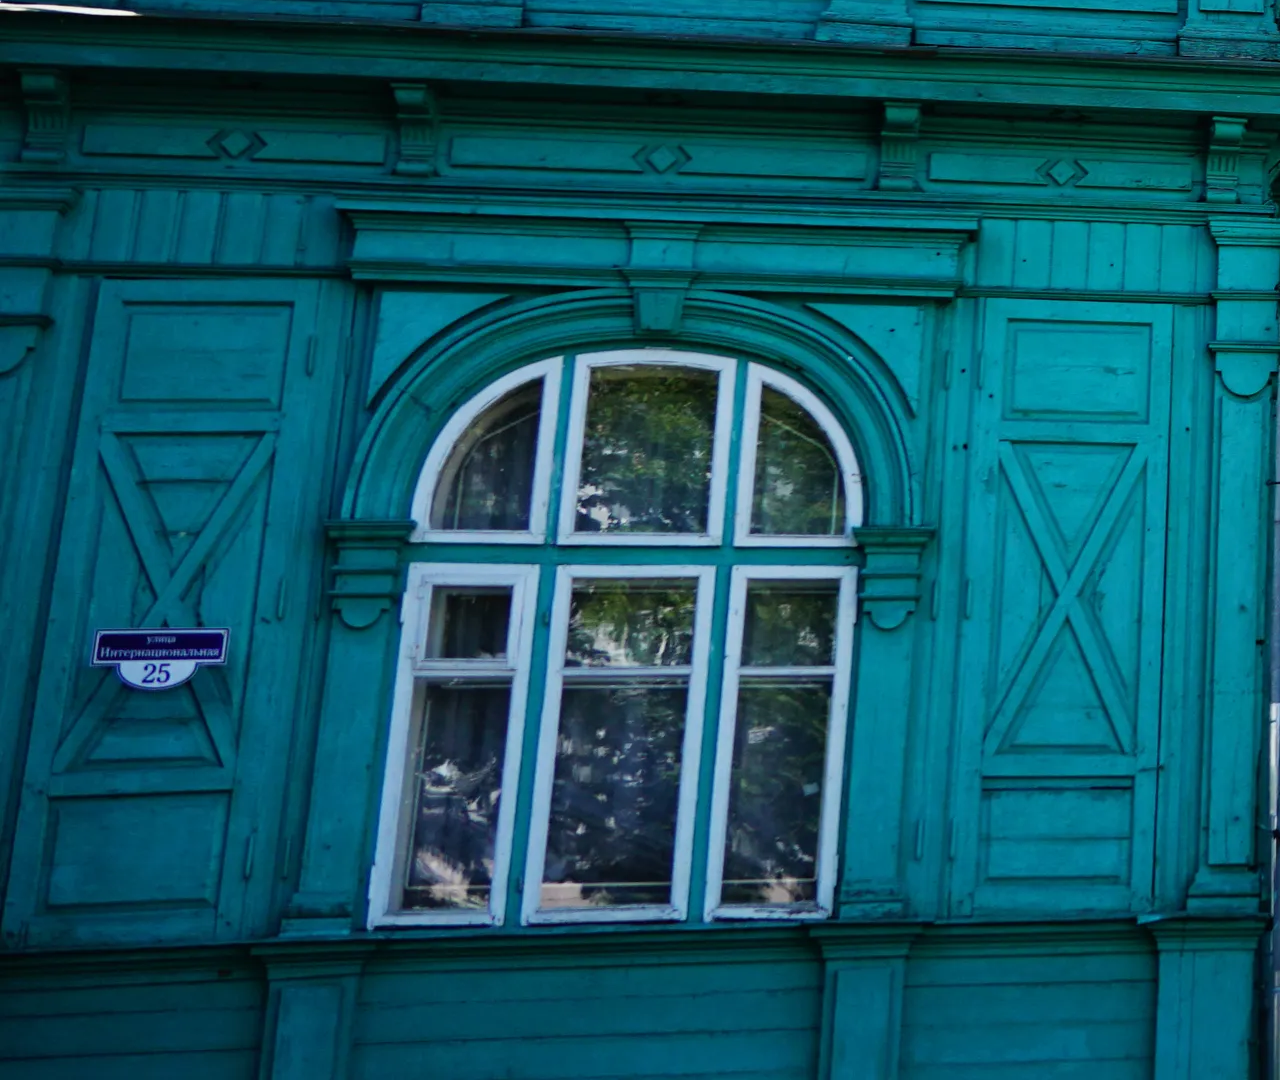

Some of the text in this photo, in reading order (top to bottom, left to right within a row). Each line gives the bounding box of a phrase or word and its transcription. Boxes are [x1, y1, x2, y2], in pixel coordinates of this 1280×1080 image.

[146, 635, 177, 645] улица
[99, 647, 220, 659] Интернациональная
[141, 663, 171, 683] 25
